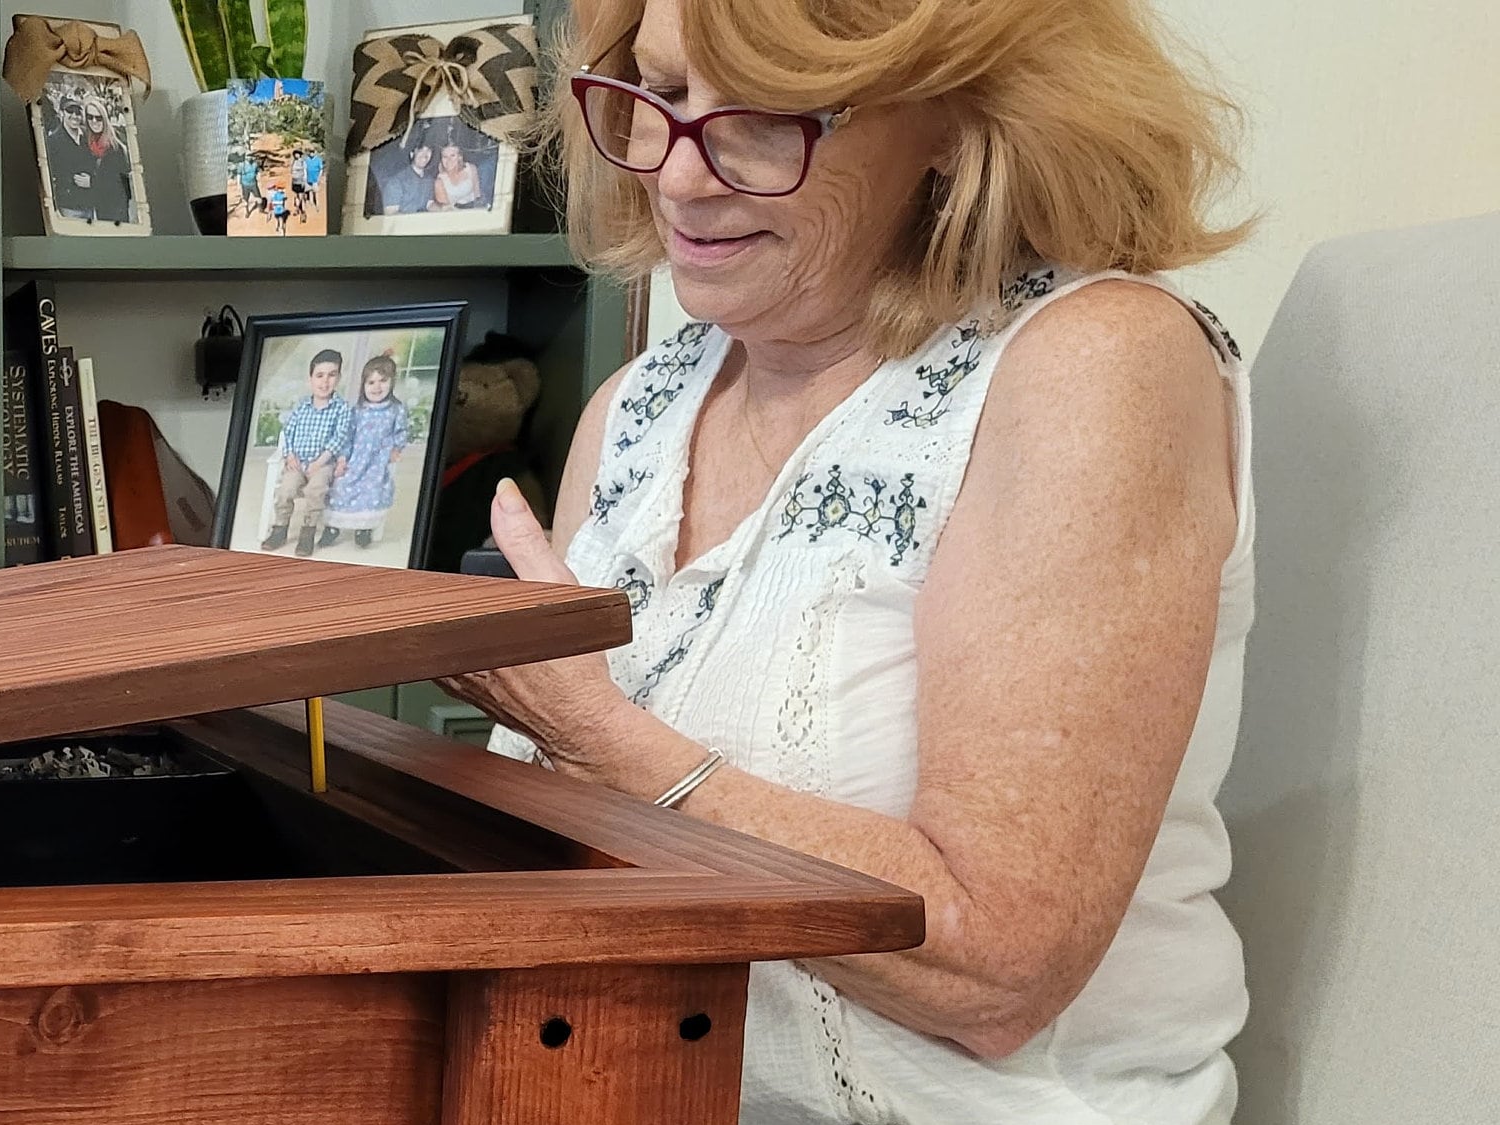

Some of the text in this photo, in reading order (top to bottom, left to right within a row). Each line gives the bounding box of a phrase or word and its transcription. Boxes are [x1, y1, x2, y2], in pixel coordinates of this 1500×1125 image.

[39, 299, 57, 355] CAVES
[47, 359, 57, 409] EXPLORING
[10, 365, 30, 480] SYSTEMATIC
[51, 412, 60, 448] HIDDEN
[88, 416, 98, 441] THE
[65, 405, 85, 534] EXPLORE THE AMERICAS
